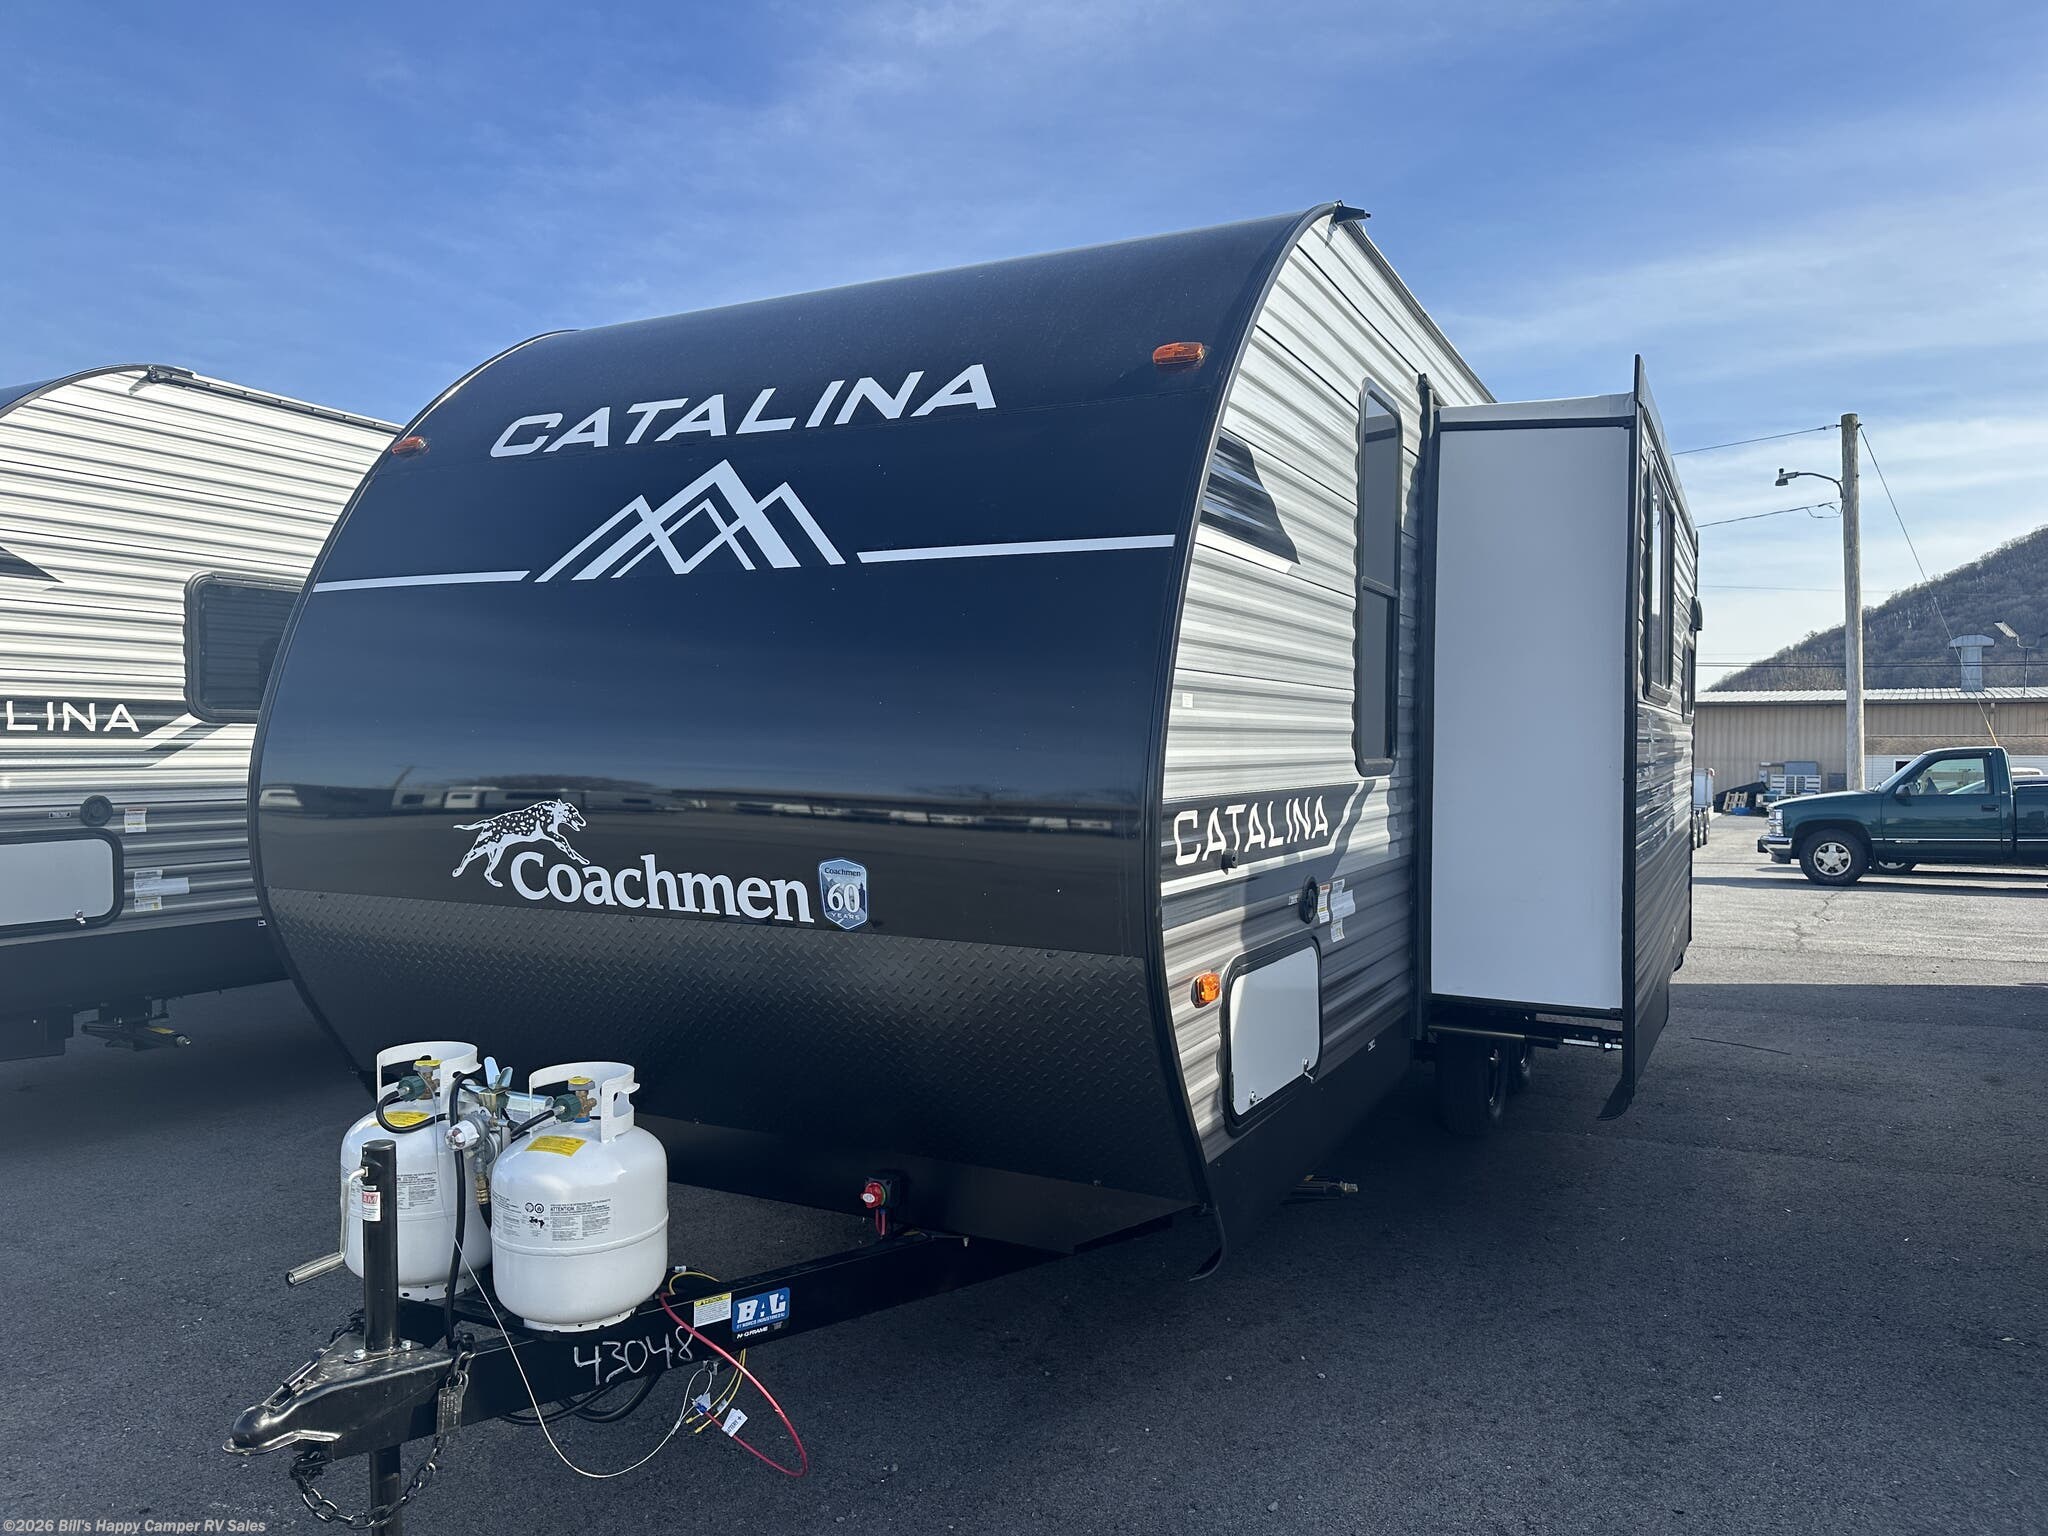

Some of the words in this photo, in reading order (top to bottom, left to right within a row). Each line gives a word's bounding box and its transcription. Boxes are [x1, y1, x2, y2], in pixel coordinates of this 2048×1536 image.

[490, 364, 997, 458] CATALINA
[6, 700, 140, 732] LINA
[1173, 795, 1329, 866] CATALINA
[510, 851, 815, 924] Coachmen
[824, 867, 861, 877] Coachmen
[827, 883, 860, 913] 60
[831, 912, 861, 920] YEARS
[574, 1326, 694, 1386] 43048
